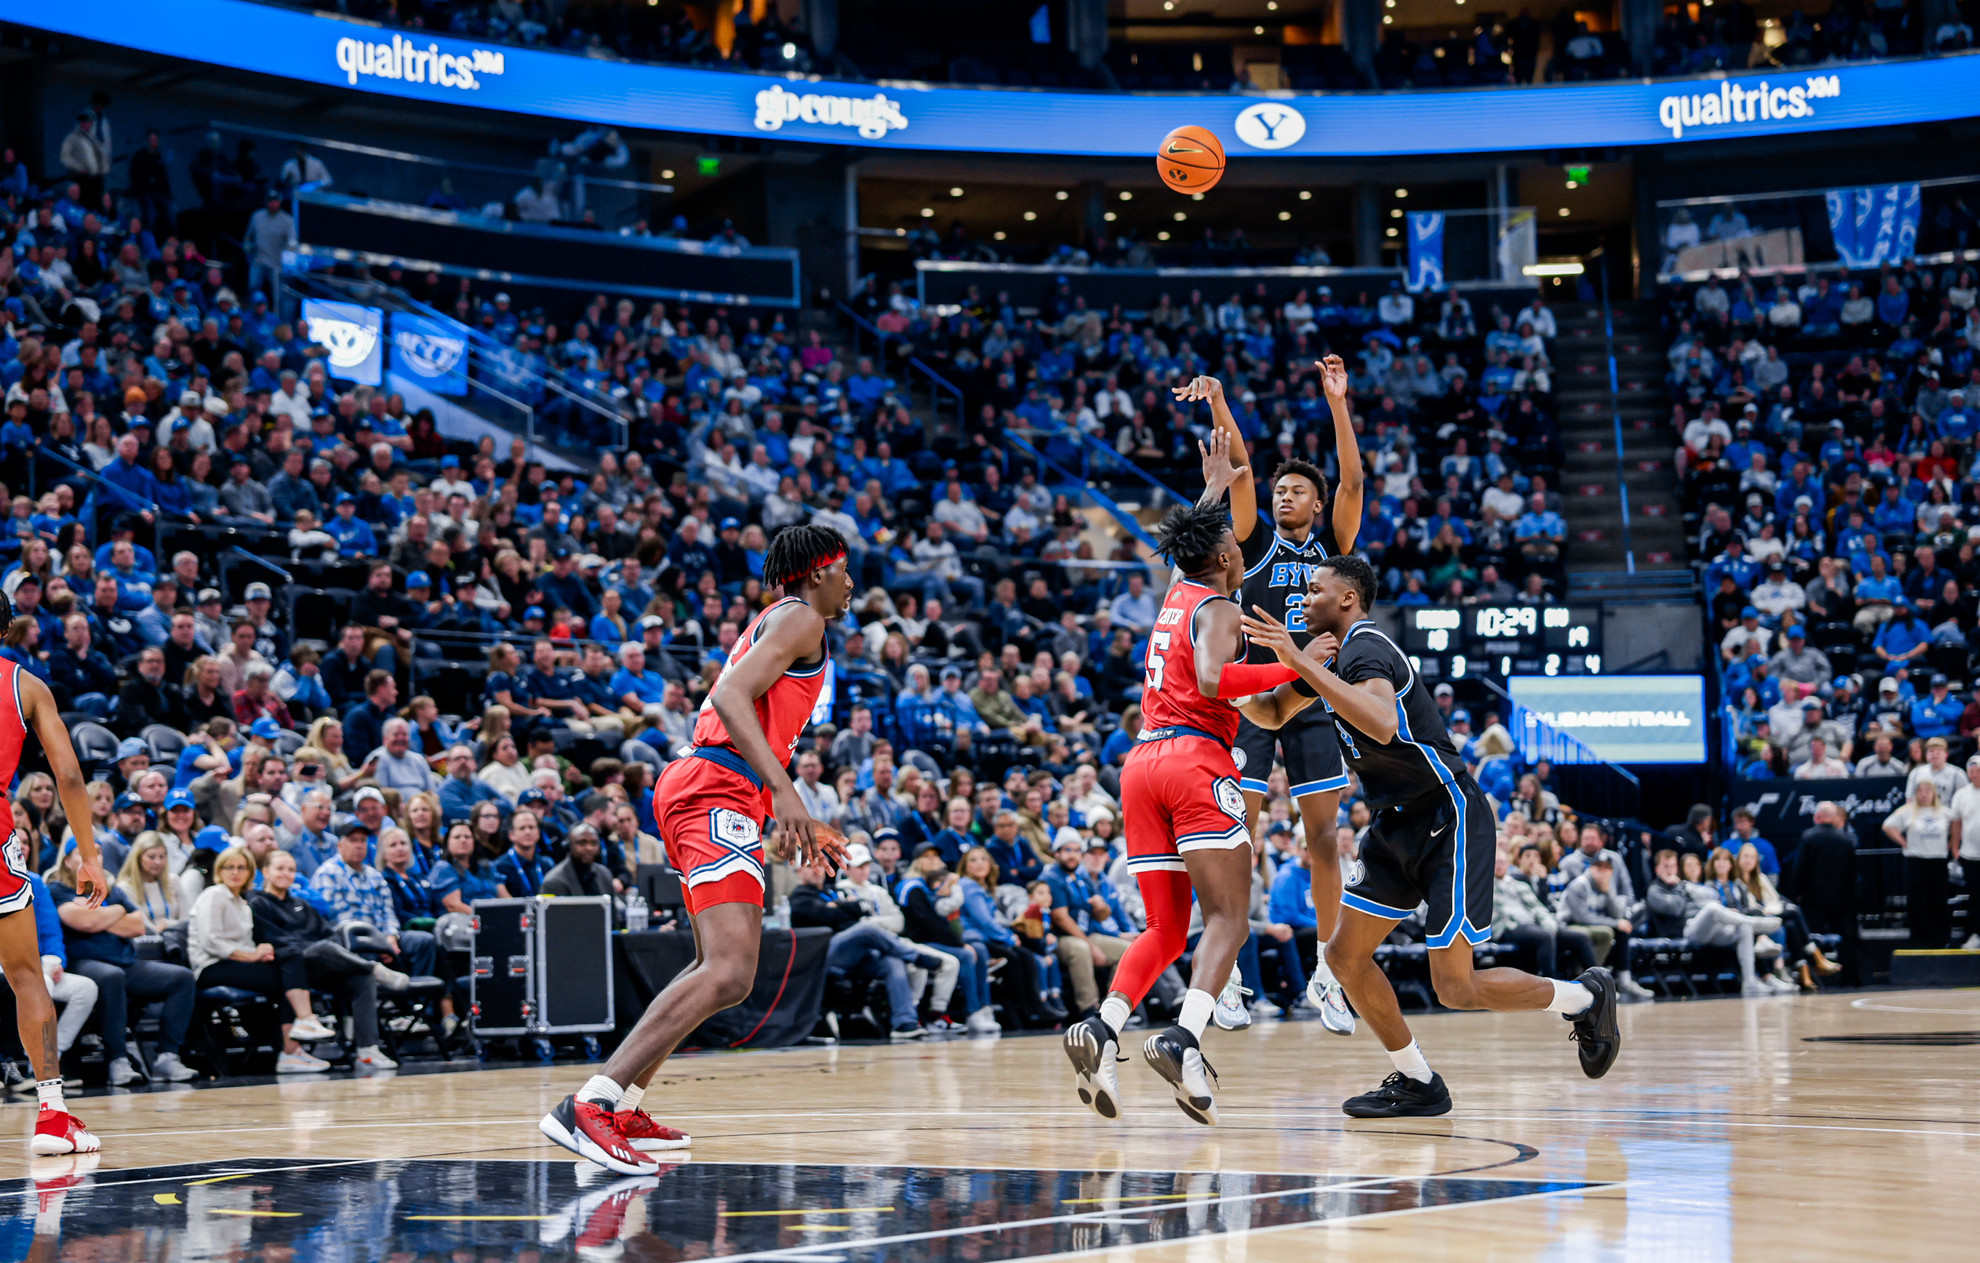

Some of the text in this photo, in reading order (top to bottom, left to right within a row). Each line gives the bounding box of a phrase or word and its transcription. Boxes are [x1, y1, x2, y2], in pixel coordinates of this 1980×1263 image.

[1252, 112, 1289, 141] Y
[1476, 607, 1537, 637] 10:29
[1145, 629, 1171, 692] 5
